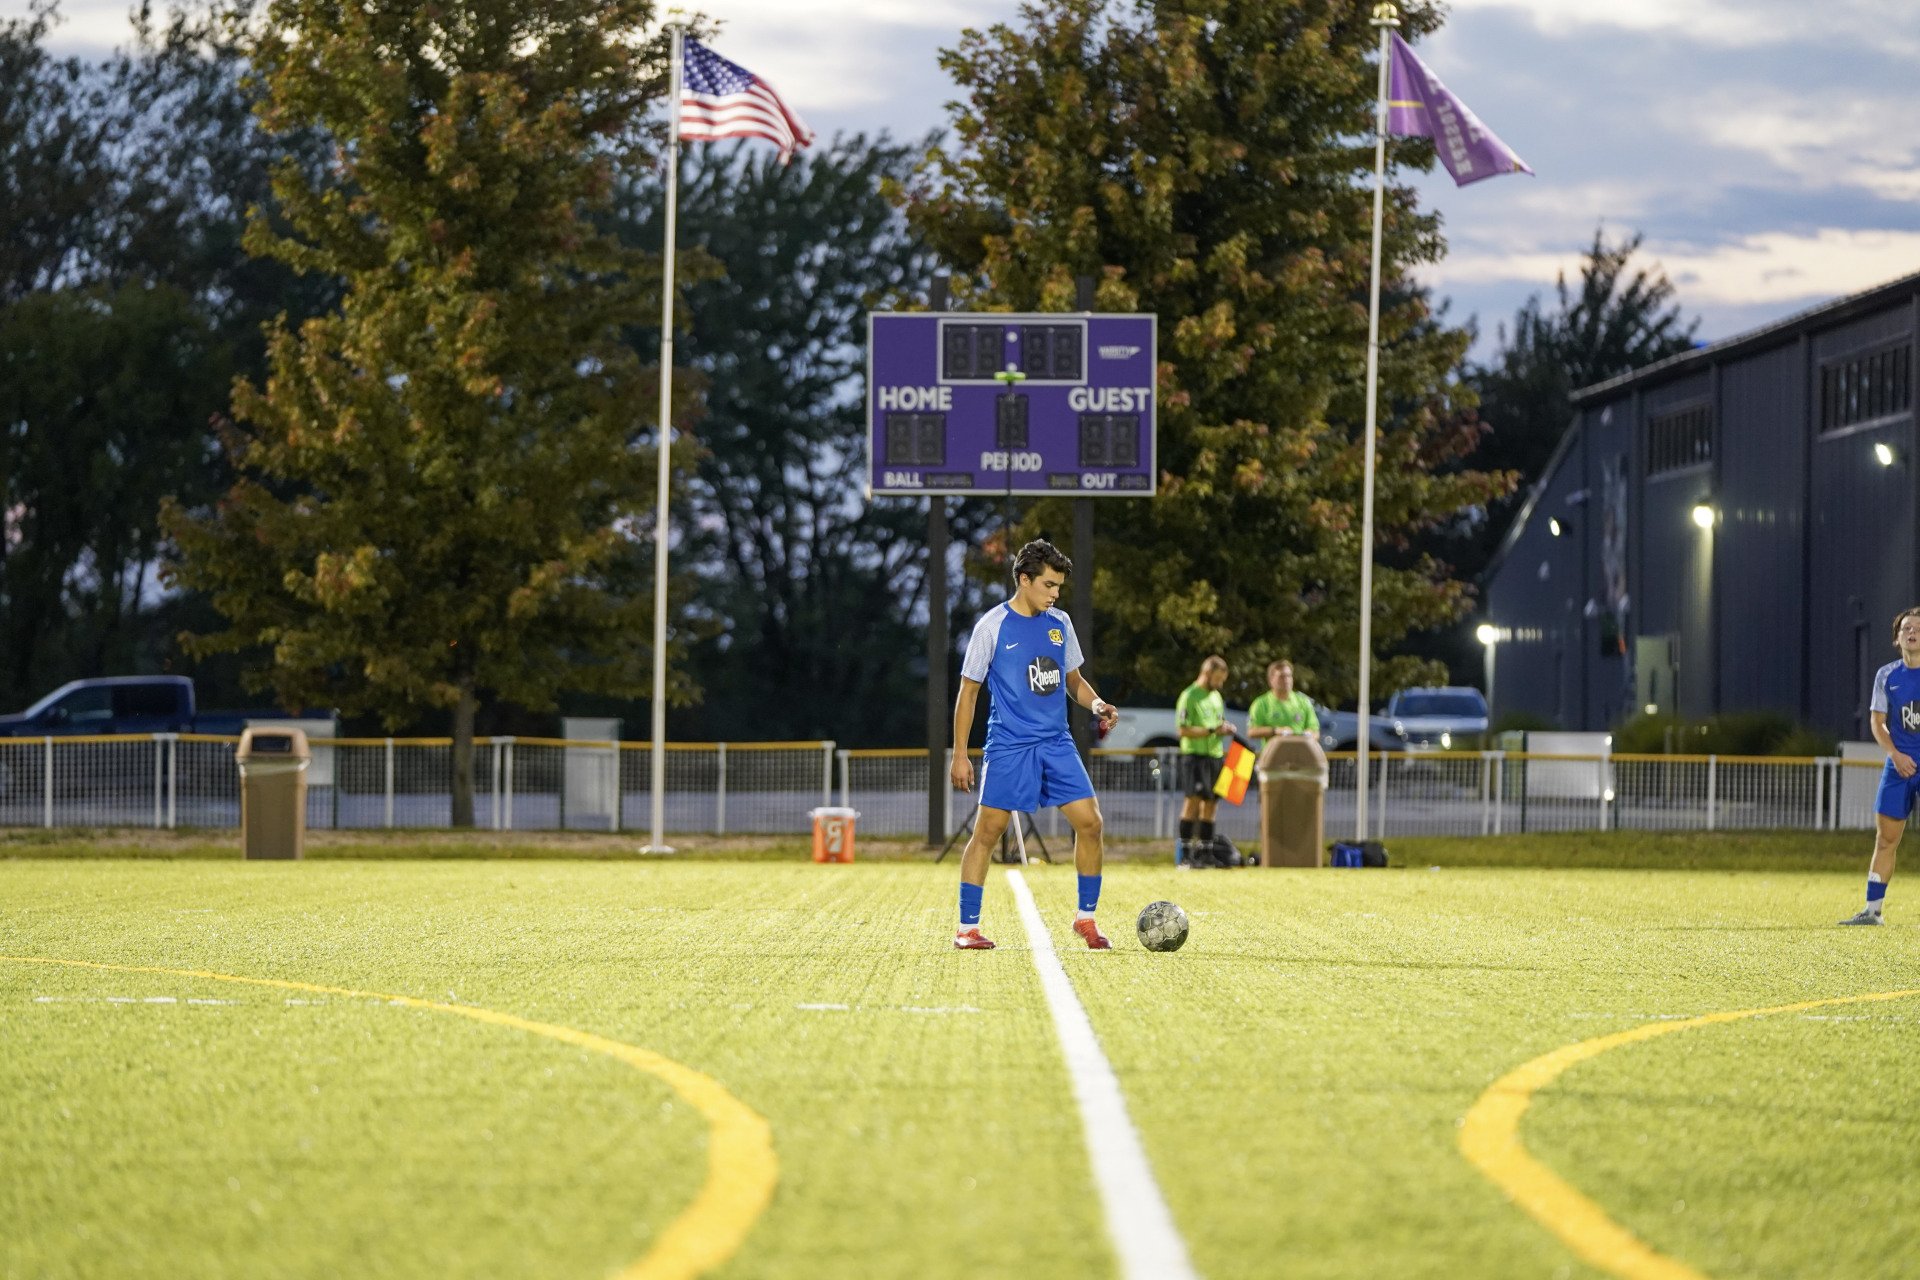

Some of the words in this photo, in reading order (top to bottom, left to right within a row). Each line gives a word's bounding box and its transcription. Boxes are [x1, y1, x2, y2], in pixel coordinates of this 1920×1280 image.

[879, 386, 952, 411] HOME
[1068, 387, 1150, 412] GUEST
[981, 452, 1042, 472] PERIOD
[884, 472, 923, 488] BALL
[1081, 473, 1117, 489] OUT
[1029, 657, 1060, 692] Rheem
